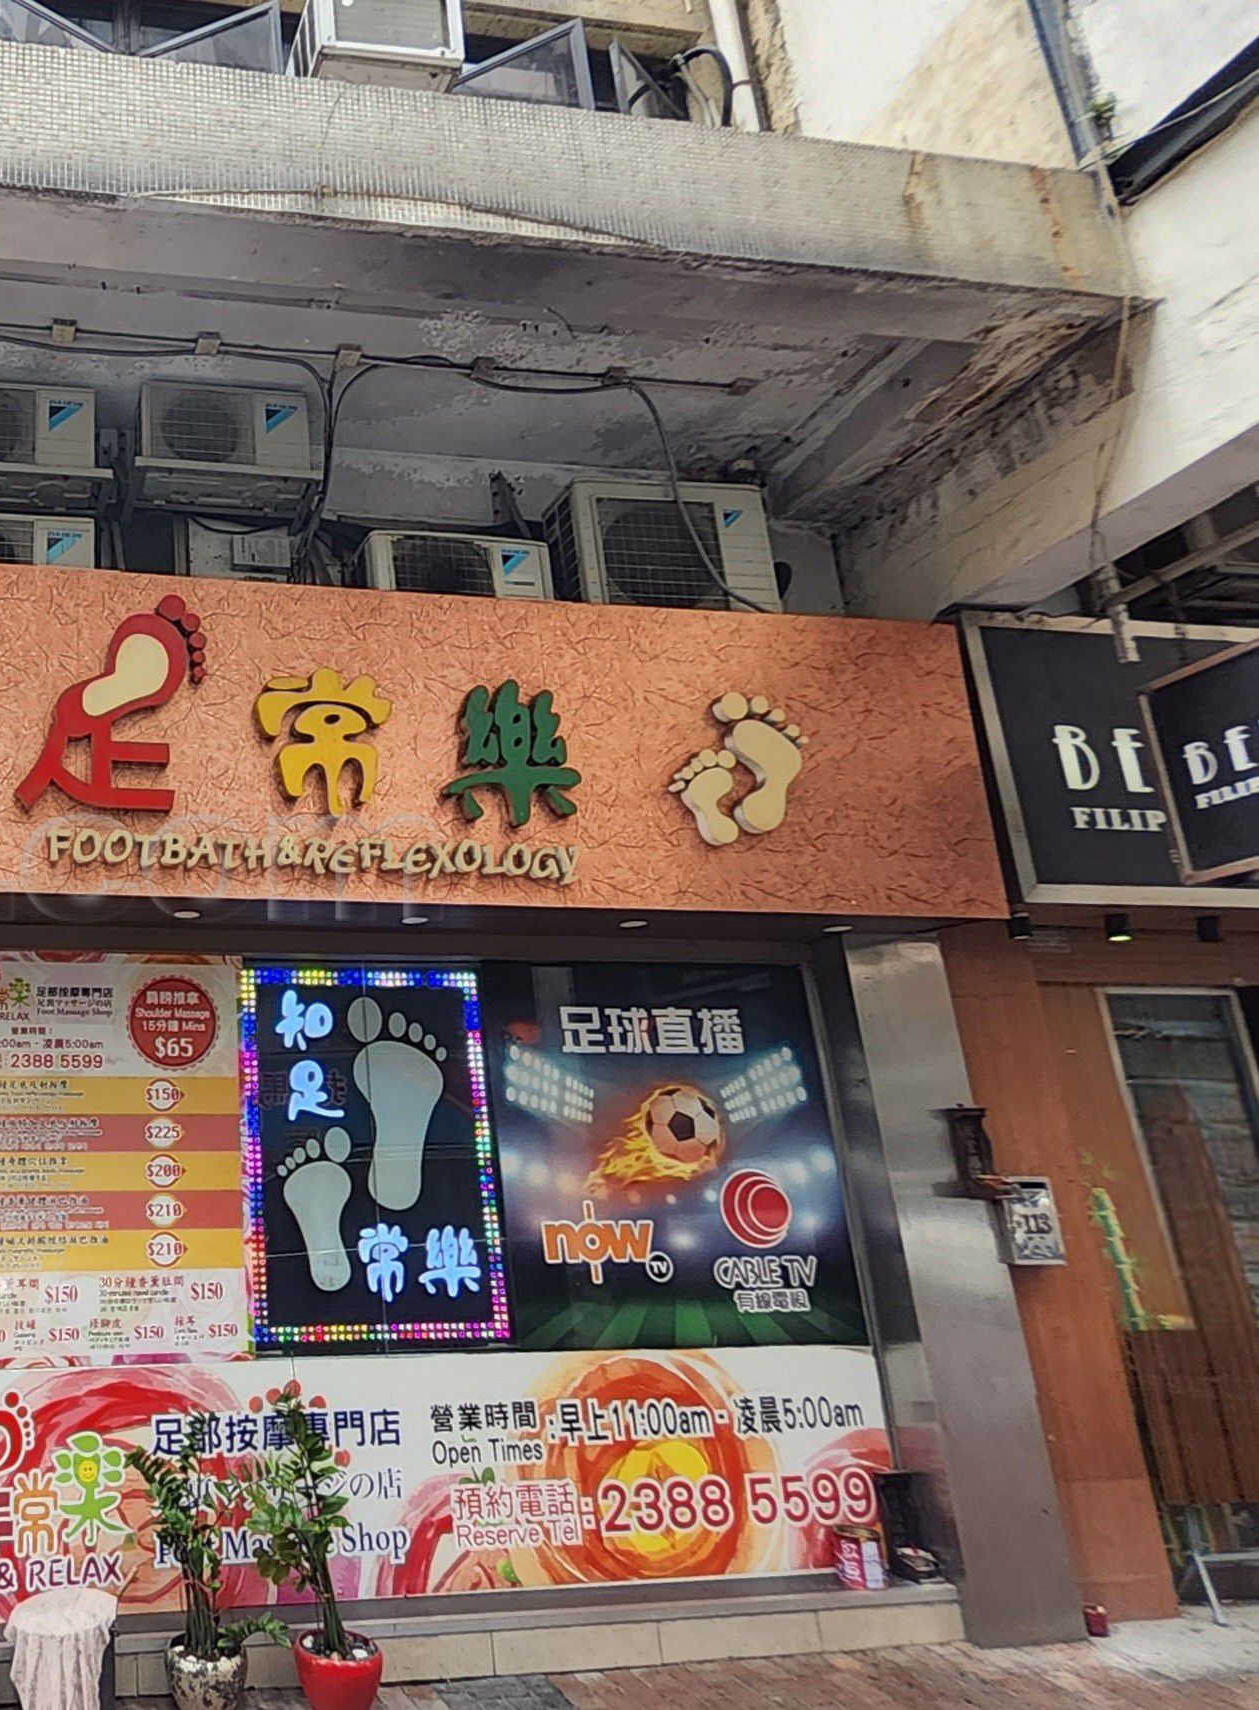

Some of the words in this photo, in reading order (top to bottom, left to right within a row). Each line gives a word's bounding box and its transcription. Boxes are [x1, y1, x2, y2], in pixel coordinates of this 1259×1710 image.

[1052, 725, 1155, 793] BE
[1183, 726, 1259, 785] BE
[1195, 777, 1259, 810] FILIP
[1070, 807, 1167, 832] FILIP
[0, 1012, 30, 1021] RELAX
[559, 1006, 745, 1055] 足球直播
[154, 1036, 193, 1058] $65
[10, 1054, 54, 1069] 2388
[60, 1054, 103, 1069] 5599
[146, 1087, 179, 1101] $150
[146, 1125, 180, 1139] $225
[147, 1163, 181, 1177] $200
[146, 1203, 182, 1217] $210
[148, 1242, 183, 1256] $210
[543, 1203, 654, 1284] now
[359, 1223, 480, 1302] 常樂
[714, 1257, 783, 1289] CABLE
[782, 1255, 817, 1286] TV
[45, 1285, 79, 1304] $150
[190, 1282, 223, 1301] $150
[49, 1327, 80, 1342] $150
[133, 1325, 164, 1340] $150
[208, 1323, 238, 1339] $150
[432, 1442, 482, 1467] Open
[488, 1439, 543, 1462] Times
[601, 1482, 731, 1533] 2388
[748, 1470, 874, 1524] 5599
[342, 1521, 408, 1560] Shop
[457, 1524, 540, 1548] Reserve
[546, 1520, 581, 1546] Tel
[29, 1555, 122, 1588] RELAX
